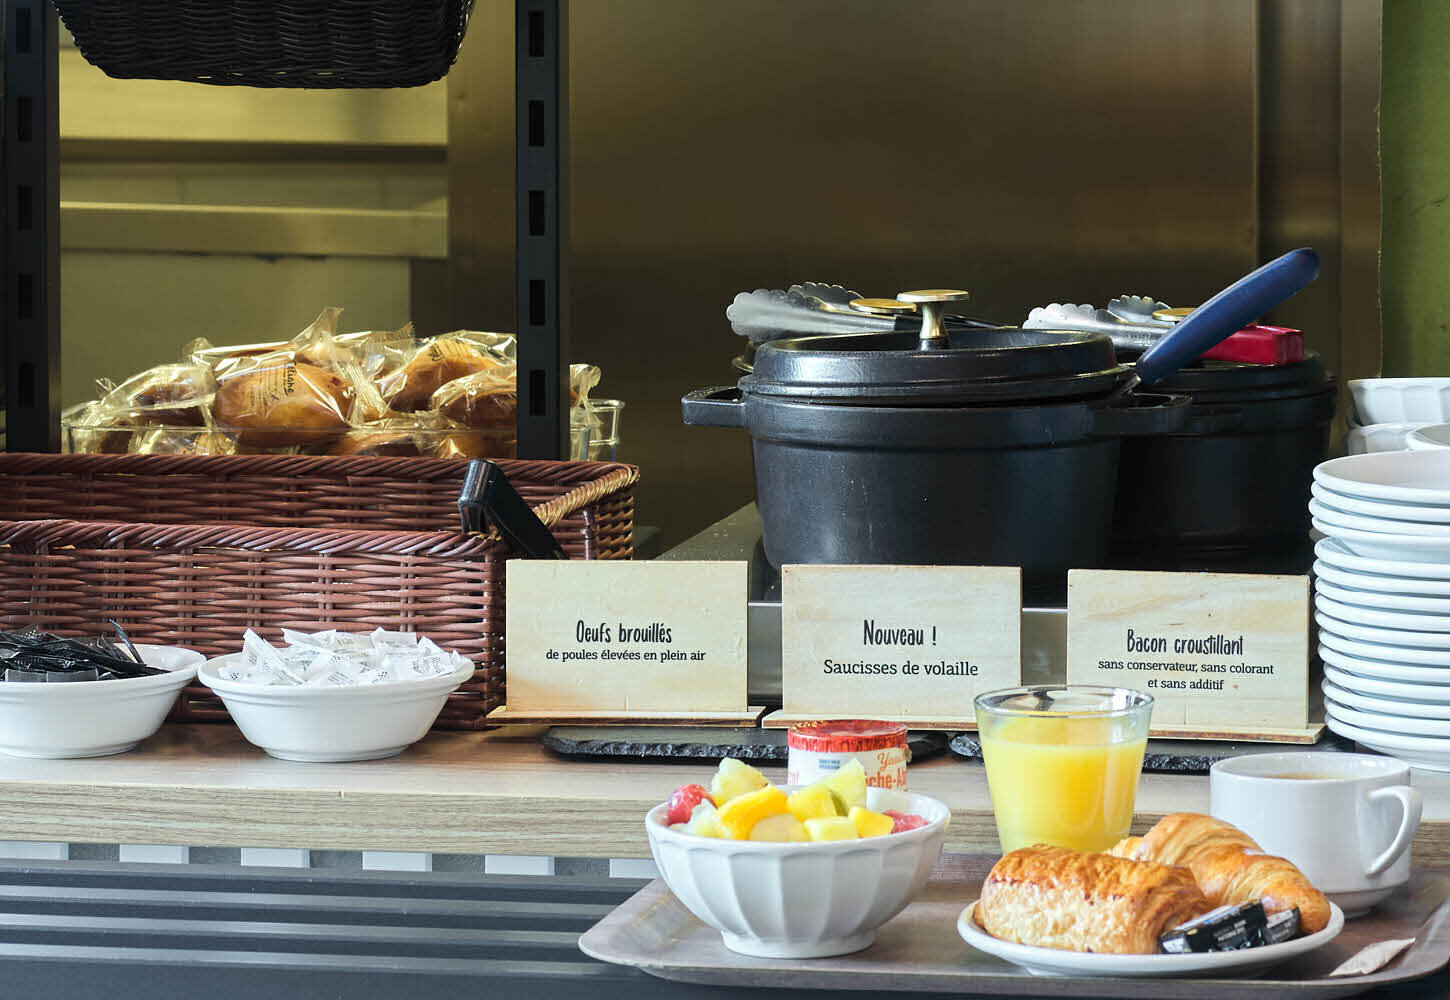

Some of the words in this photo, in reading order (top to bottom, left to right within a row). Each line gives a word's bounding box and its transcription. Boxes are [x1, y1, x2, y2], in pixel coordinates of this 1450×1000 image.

[576, 619, 612, 644] Oeufs
[618, 622, 672, 644] brouillés
[863, 619, 924, 646] Nouveau
[1127, 628, 1167, 653] Bacon
[1173, 634, 1244, 656] croustillant
[545, 648, 560, 660] de
[562, 648, 598, 663] poules
[600, 649, 641, 661] élevées
[643, 652, 658, 661] en
[660, 649, 688, 663] plein
[689, 650, 707, 661] air
[823, 659, 898, 675] Saucisses
[901, 660, 920, 675] de
[923, 660, 978, 676] volaille
[1098, 660, 1124, 670] sans
[1126, 661, 1198, 673] conservateur,
[1200, 664, 1227, 673] sans
[1229, 662, 1274, 675] colorant
[1147, 679, 1158, 688] et
[1160, 680, 1187, 689] sans
[1189, 678, 1225, 690] additif
